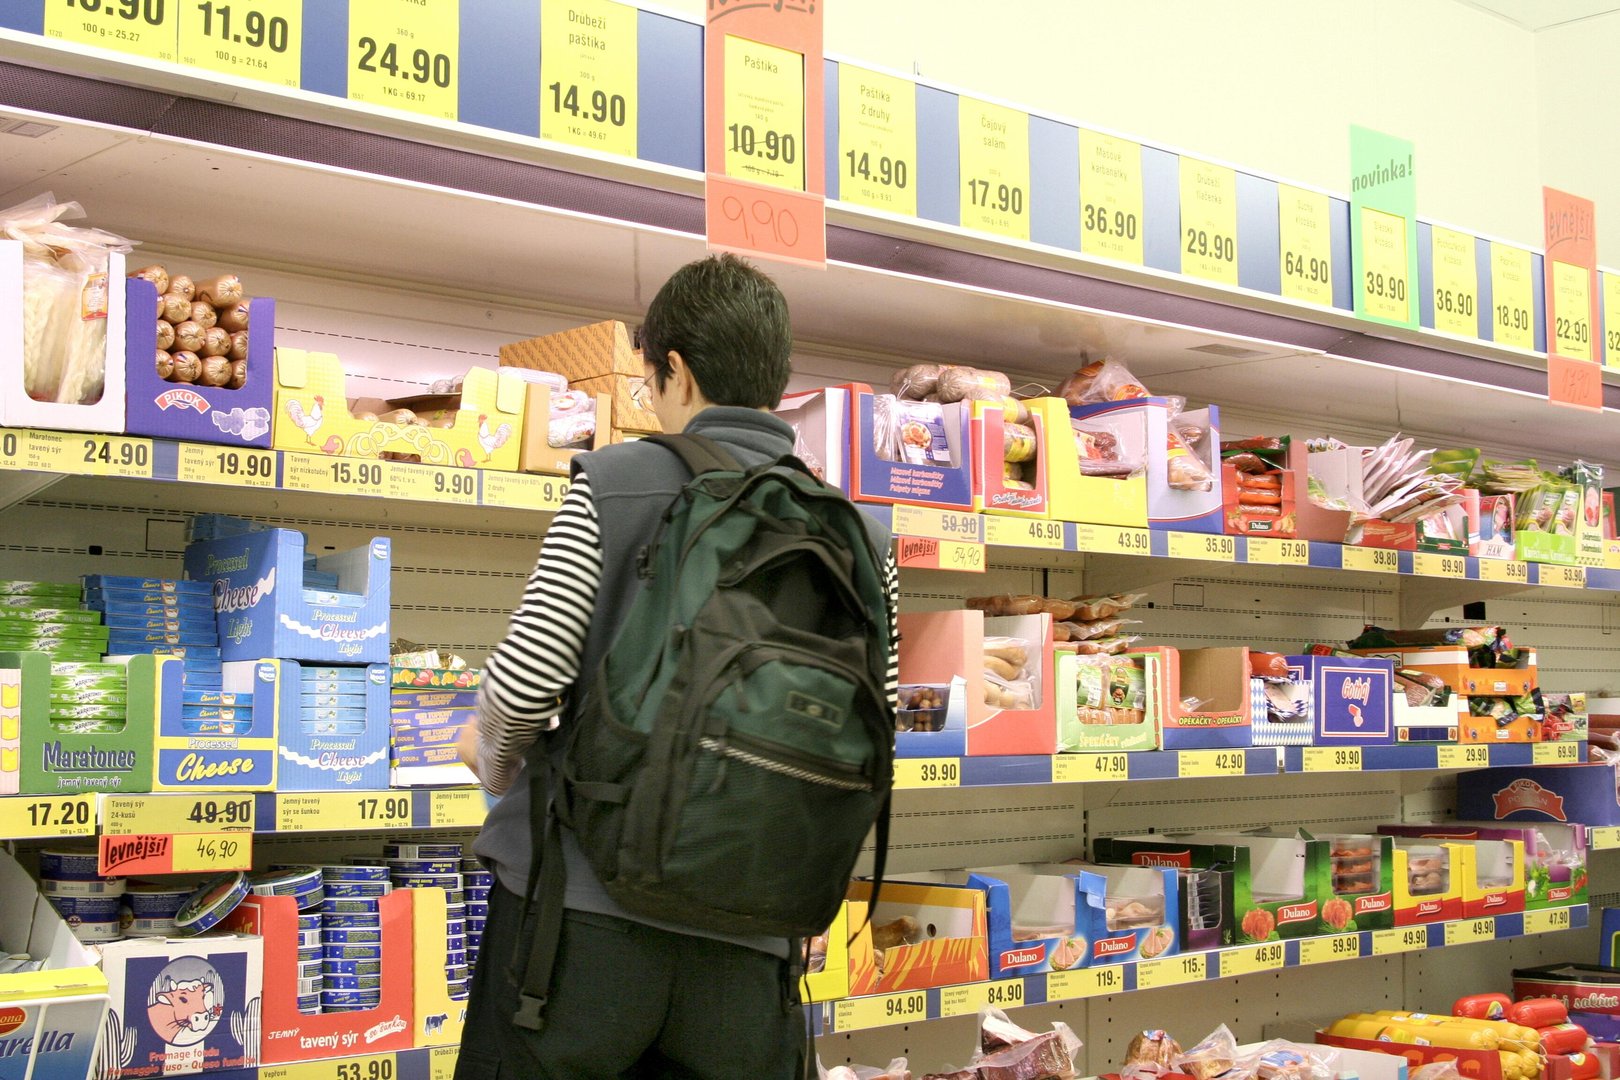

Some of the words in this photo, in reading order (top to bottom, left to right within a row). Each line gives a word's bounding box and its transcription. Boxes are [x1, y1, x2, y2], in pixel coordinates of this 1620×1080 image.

[82, 22, 98, 34] 100
[100, 28, 106, 37] g
[115, 29, 140, 42] 25.27
[198, 1, 289, 53] 11.90
[569, 31, 606, 51] paštika
[215, 50, 229, 62] 100
[231, 55, 237, 64] g
[246, 56, 268, 70] 21.64
[358, 37, 450, 88] 24.90
[744, 55, 778, 74] Paštika
[388, 87, 398, 98] KG
[406, 90, 426, 103] 69.17
[860, 84, 890, 103] Paštika
[549, 81, 626, 127] 14.90
[861, 104, 866, 115] 2
[868, 106, 890, 123] druhy
[981, 113, 1006, 135] Čajový
[572, 127, 581, 137] KG
[588, 129, 607, 141] 49.67
[983, 134, 1006, 150] salám
[729, 123, 795, 164] 10.90
[846, 149, 907, 189] 14.90
[1352, 154, 1412, 192] novinka!
[968, 178, 1023, 215] 17.90
[722, 196, 799, 247] 9,90
[1084, 204, 1137, 240] 36.90
[1187, 228, 1234, 262] 29.90
[1285, 251, 1328, 284] 64.90
[1366, 271, 1405, 302] 39.90
[1436, 288, 1473, 317] 36.90
[1497, 305, 1529, 331] 18.90
[1557, 317, 1588, 344] 22.90
[164, 391, 202, 408] PIKOK
[29, 432, 62, 443] Maratonec
[29, 443, 50, 455] tavený
[52, 446, 62, 455] sýr
[84, 440, 148, 468] 24.90
[217, 453, 272, 478] 19.90
[331, 462, 382, 486] 15.90
[390, 465, 406, 474] Jemný
[407, 466, 425, 476] tavený
[434, 472, 474, 496] 9.90
[942, 514, 977, 535] 59.90
[1029, 522, 1060, 540] 46.90
[1118, 532, 1147, 549] 43.90
[1206, 538, 1232, 553] 35.90
[901, 539, 937, 560] levnější!
[1281, 543, 1306, 557] 57.90
[205, 548, 249, 576] Processed
[1442, 560, 1463, 573] 99.90
[1507, 564, 1526, 577] 59.90
[1564, 569, 1582, 582] 53.90
[213, 579, 259, 611] Cheese
[312, 609, 358, 623] Processed
[227, 617, 253, 645] Light
[320, 623, 367, 640] Cheese
[338, 642, 363, 656] Light
[188, 738, 239, 750] Processed
[310, 740, 356, 751] Processed
[1557, 745, 1576, 758] 69.90
[43, 741, 136, 773] Maratonec
[318, 751, 365, 767] Cheese
[1215, 754, 1243, 768] 42.90
[1335, 751, 1360, 764] 39.90
[1466, 748, 1487, 761] 29.90
[176, 752, 254, 781] Cheese
[921, 764, 957, 781] 39.90
[1095, 756, 1126, 772] 47.90
[57, 776, 81, 788] jemný
[84, 776, 107, 787] tavený
[109, 776, 121, 788] sýr
[336, 770, 363, 785] Light
[111, 800, 134, 810] Tavený
[135, 801, 145, 810] sýr
[282, 797, 301, 806] Jemný
[302, 797, 320, 805] tavený
[435, 793, 452, 801] Jemný
[453, 792, 470, 800] tavený
[27, 801, 89, 826] 17.20
[111, 809, 136, 819] 24-kusů
[190, 800, 252, 824] 49.90
[283, 807, 292, 815] sýr
[358, 798, 409, 820] 17.90
[436, 803, 445, 811] sýr
[105, 837, 168, 867] levnější!
[197, 838, 237, 860] 46,90
[1140, 855, 1180, 868] Dulano
[1361, 898, 1385, 909] Dulano
[1284, 907, 1310, 919] Dulano
[1549, 911, 1568, 925] 47.90
[1473, 921, 1494, 935] 49.90
[1101, 940, 1129, 952] Dulano
[1333, 937, 1357, 953] 59.90
[1403, 930, 1425, 945] 49.90
[1007, 953, 1037, 965] Dulano
[1255, 945, 1281, 963] 46.90
[1182, 959, 1205, 974] 115.-
[1096, 970, 1121, 987] 119.-
[988, 983, 1022, 1004] 84.90
[1573, 993, 1618, 1008] salám
[886, 995, 924, 1016] 94.90
[268, 1028, 299, 1040] JEMNÝ
[300, 1031, 338, 1049] tavený
[342, 1030, 359, 1046] sýr
[150, 1049, 191, 1063] Fromage
[193, 1048, 220, 1060] fondu
[164, 1061, 183, 1073] fuso
[191, 1057, 221, 1072] Queso
[337, 1059, 392, 1080] 53.90
[264, 1069, 287, 1079] Vepřové
